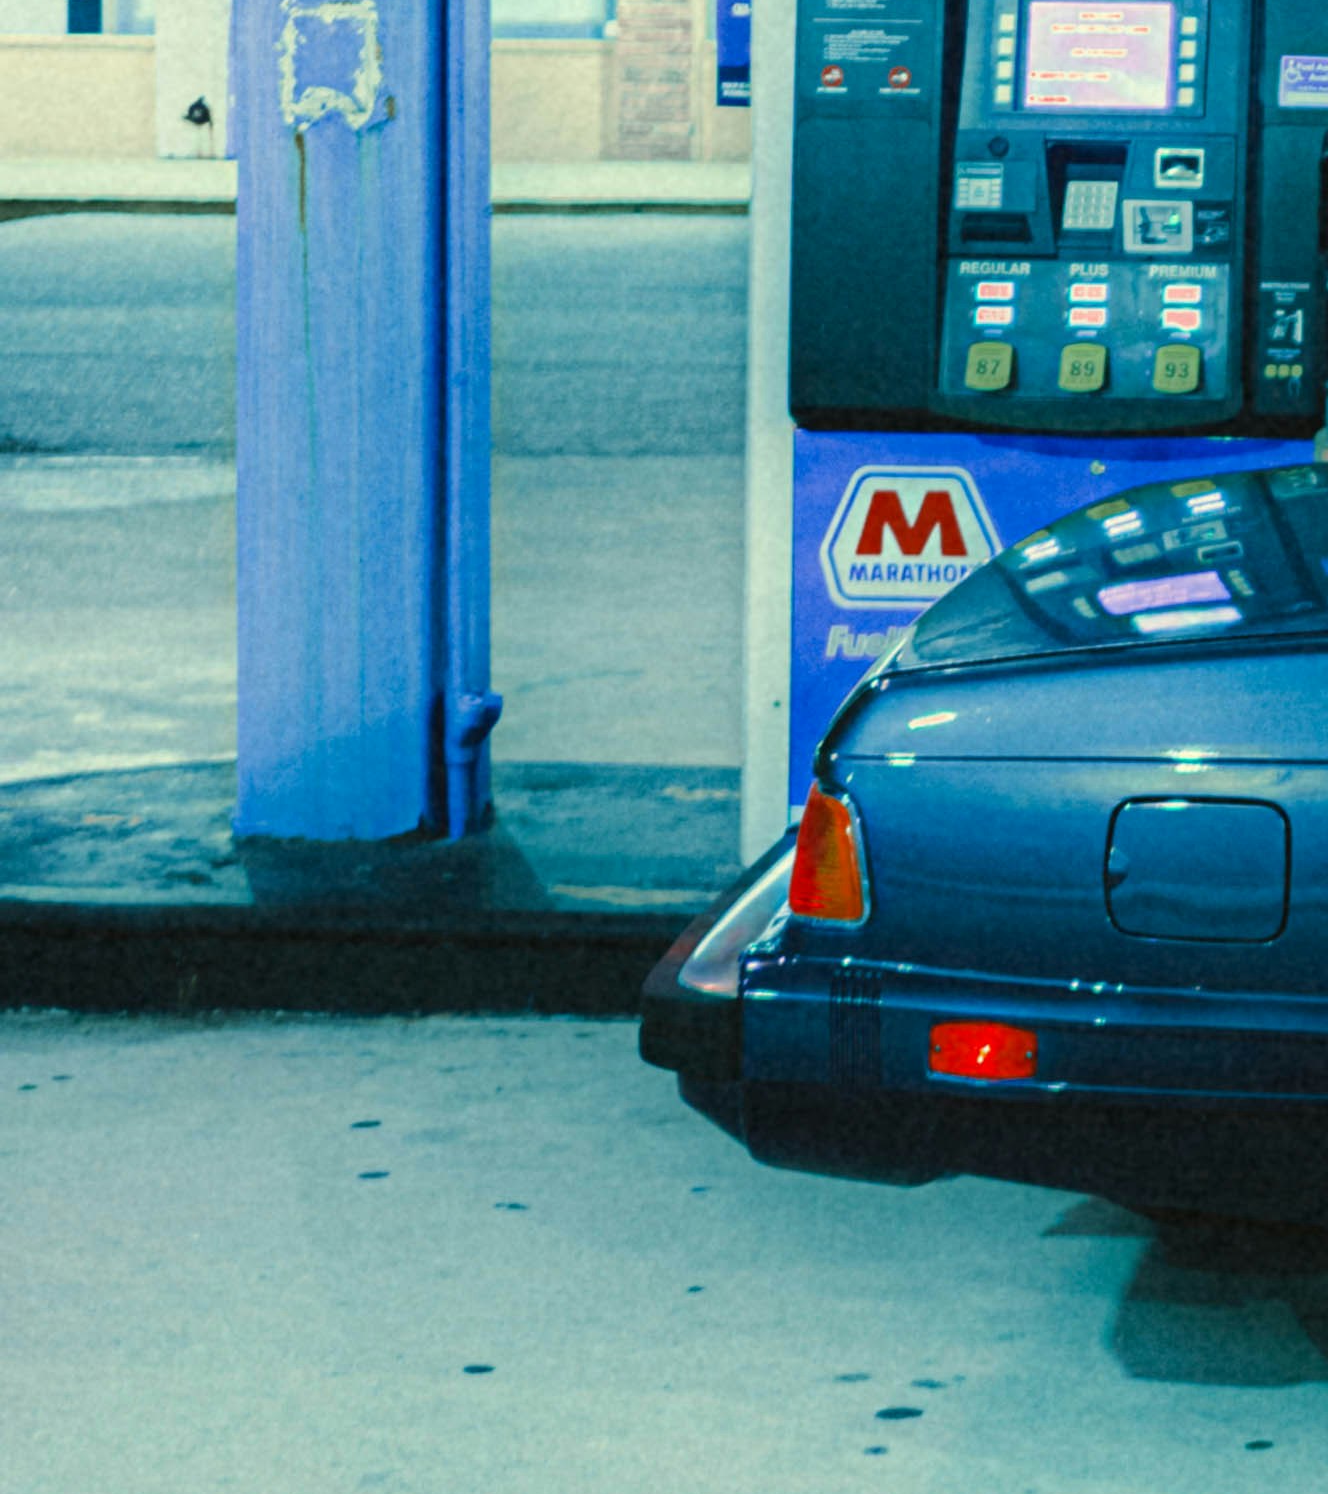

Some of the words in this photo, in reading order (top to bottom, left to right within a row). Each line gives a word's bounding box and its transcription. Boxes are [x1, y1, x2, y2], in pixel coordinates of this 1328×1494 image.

[959, 262, 1031, 276] REGULAR
[1069, 263, 1109, 277] PLUS
[1148, 265, 1217, 278] PREMIUM
[975, 359, 1001, 376] 87
[1070, 360, 1095, 377] 89
[1164, 361, 1190, 378] 93
[855, 490, 968, 557] M
[824, 625, 910, 658] Fuel
